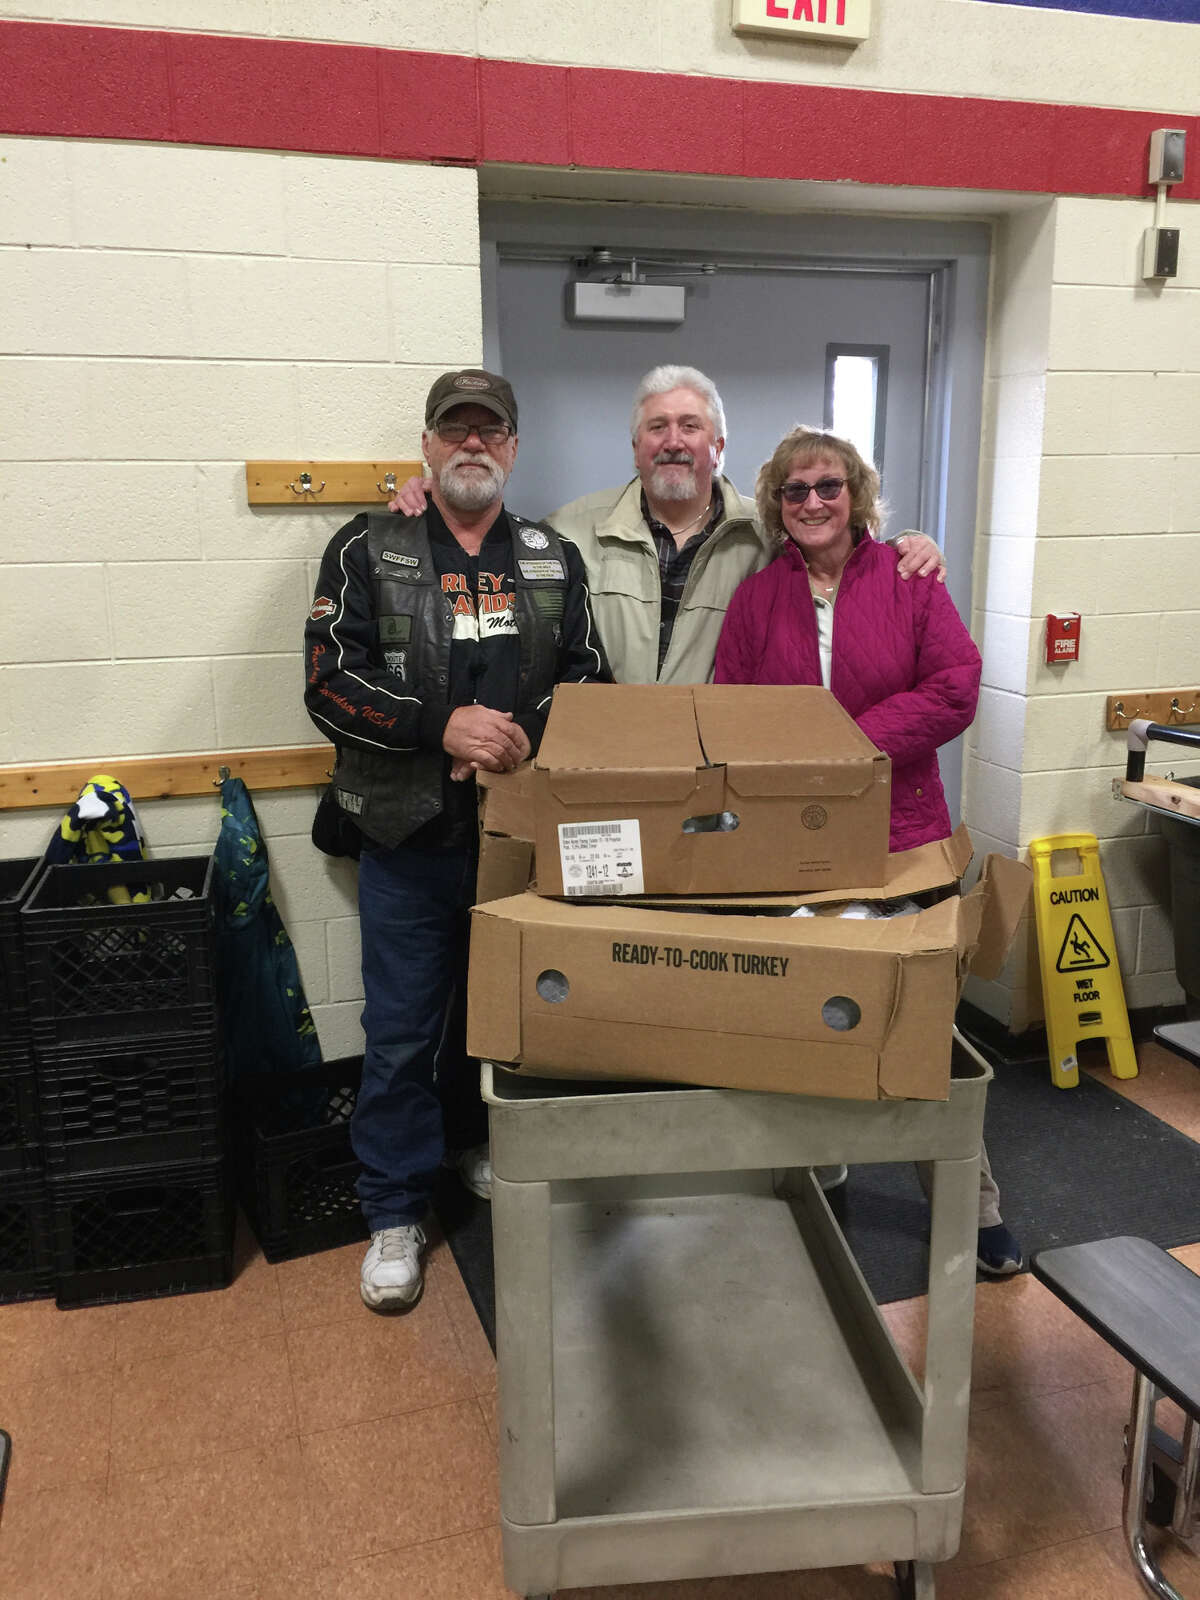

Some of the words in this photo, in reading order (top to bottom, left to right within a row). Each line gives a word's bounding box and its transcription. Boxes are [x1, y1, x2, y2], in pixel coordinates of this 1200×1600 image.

[452, 592, 516, 616] AVIDS
[487, 616, 517, 629] Mot
[1055, 639, 1076, 647] FIRE
[1050, 888, 1099, 905] CAUTION
[612, 942, 728, 972] READY-TO-COOK
[732, 953, 789, 977] TURKEY
[1075, 978, 1094, 990] WET
[1073, 991, 1100, 1003] FLOOR
